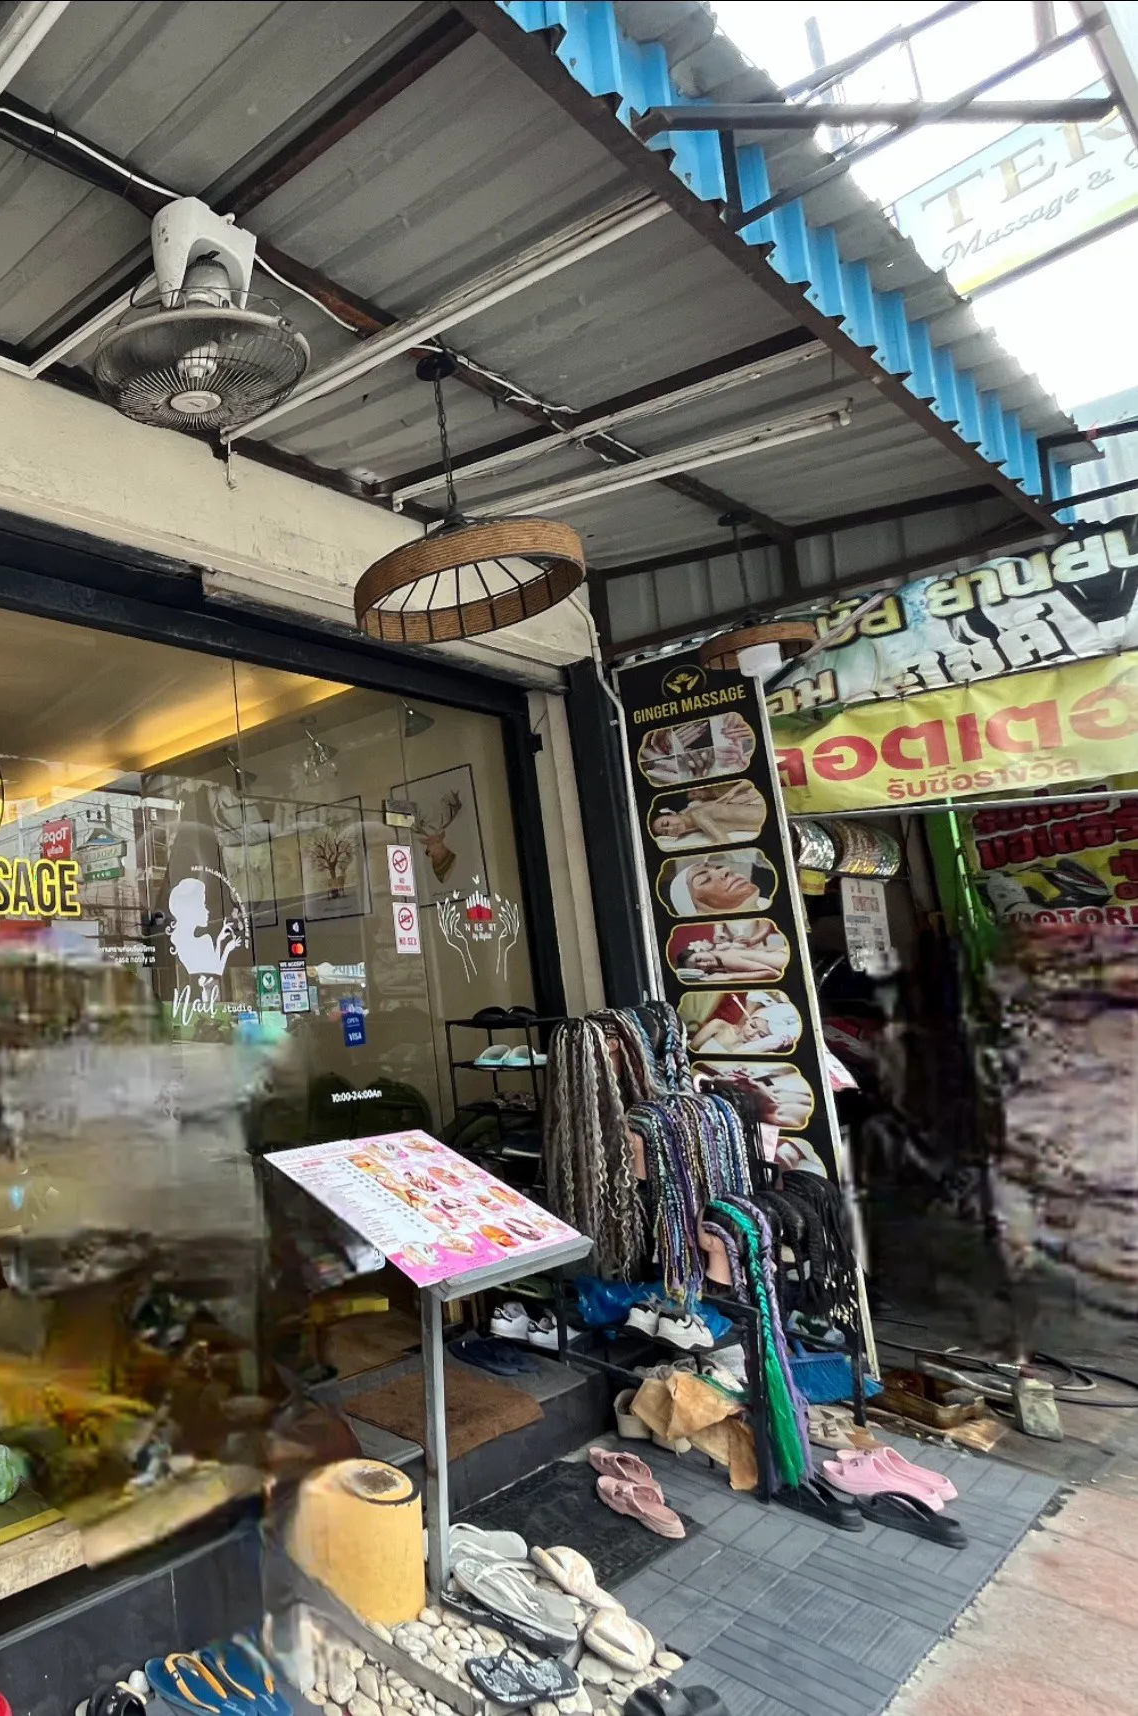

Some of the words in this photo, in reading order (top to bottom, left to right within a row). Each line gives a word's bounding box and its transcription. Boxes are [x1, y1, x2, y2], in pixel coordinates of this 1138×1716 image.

[942, 188, 1079, 267] Massage
[1087, 169, 1115, 191] &
[633, 702, 678, 724] GINGER
[681, 685, 746, 713] MASSAGE
[886, 756, 1079, 800] รับซื้อรางวัล
[1011, 905, 1138, 925] OTOR
[408, 937, 417, 945] SEX
[284, 972, 296, 980] VISA
[348, 1032, 362, 1041] VISA
